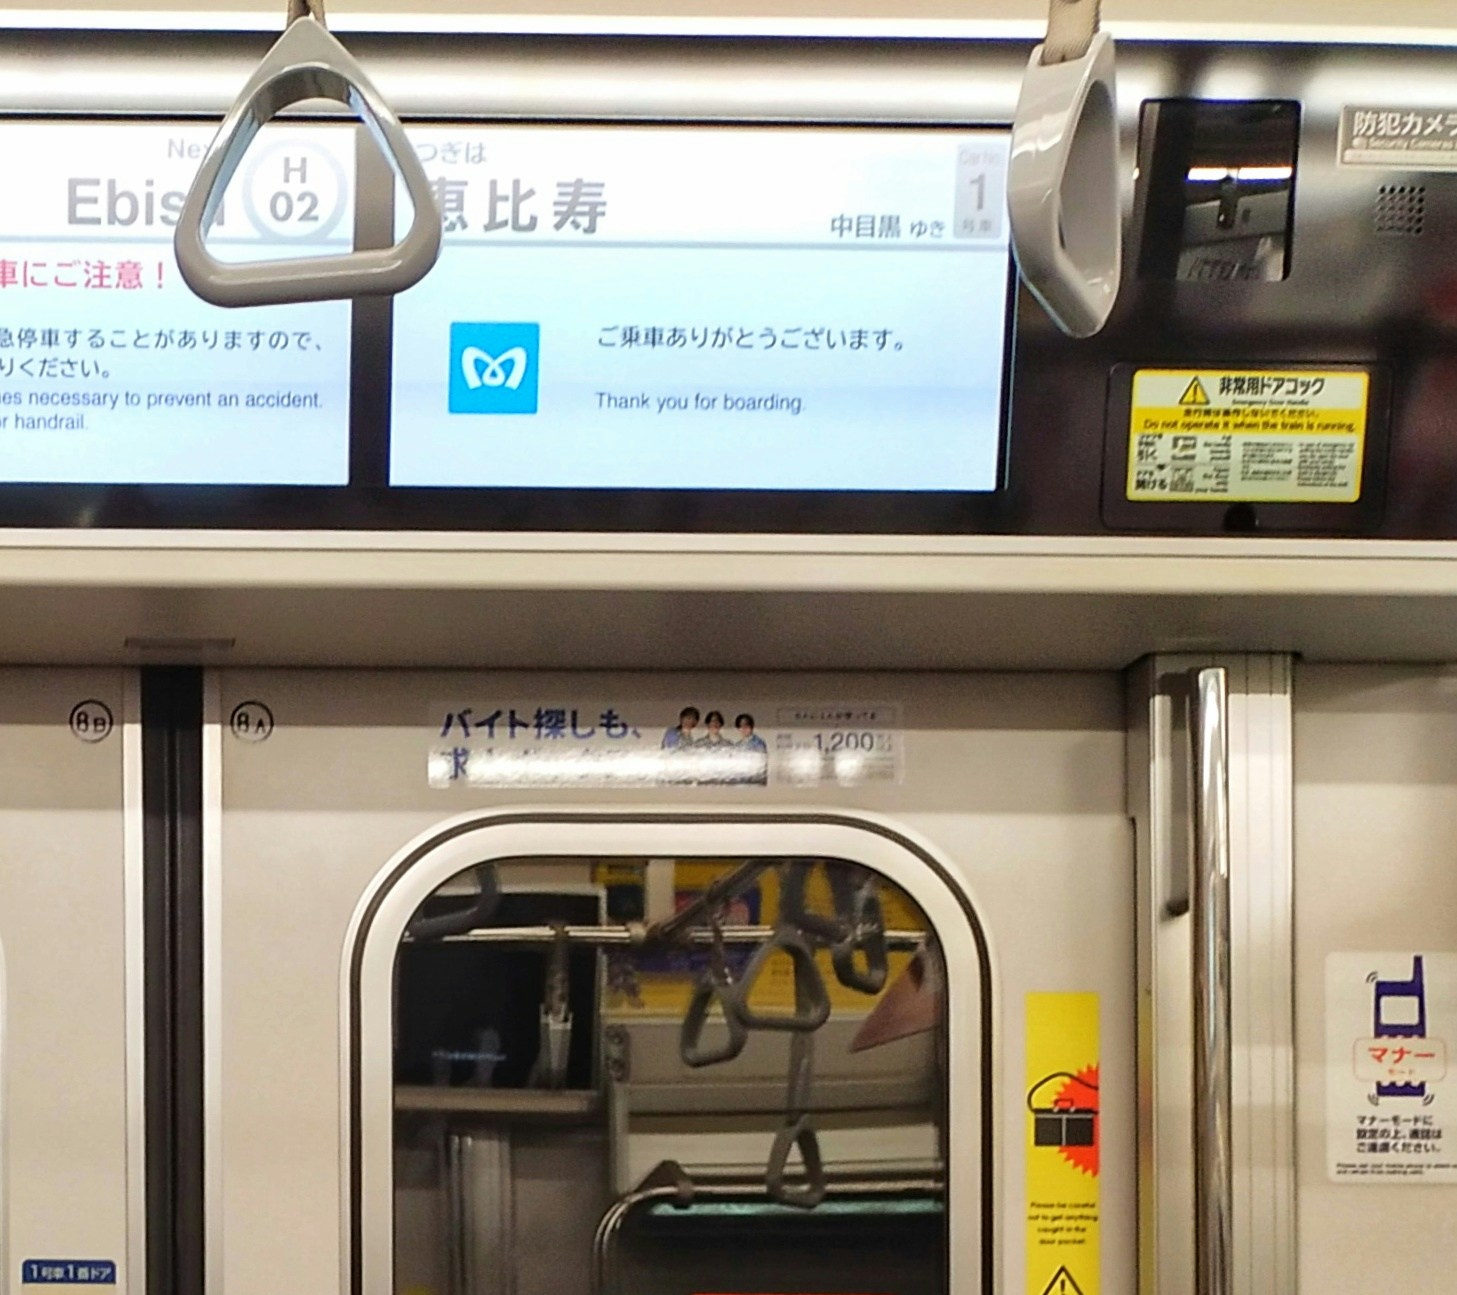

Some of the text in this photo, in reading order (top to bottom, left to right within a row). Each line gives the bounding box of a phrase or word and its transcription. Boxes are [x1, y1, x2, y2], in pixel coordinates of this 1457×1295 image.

[416, 141, 487, 165] つぎは
[283, 157, 307, 184] H
[66, 177, 226, 228] Ebis
[269, 190, 320, 222] 02
[831, 215, 902, 239] 中目黒
[597, 325, 903, 351] ご乗車ありがとうございます。
[28, 391, 119, 411] necessary
[125, 391, 141, 407] to
[147, 391, 213, 410] prevent
[218, 394, 240, 408] an
[245, 391, 324, 409] accident.
[595, 392, 806, 416] Thank you for boarding.
[441, 708, 644, 740] バイト探しも、
[1368, 1047, 1436, 1064] マナー
